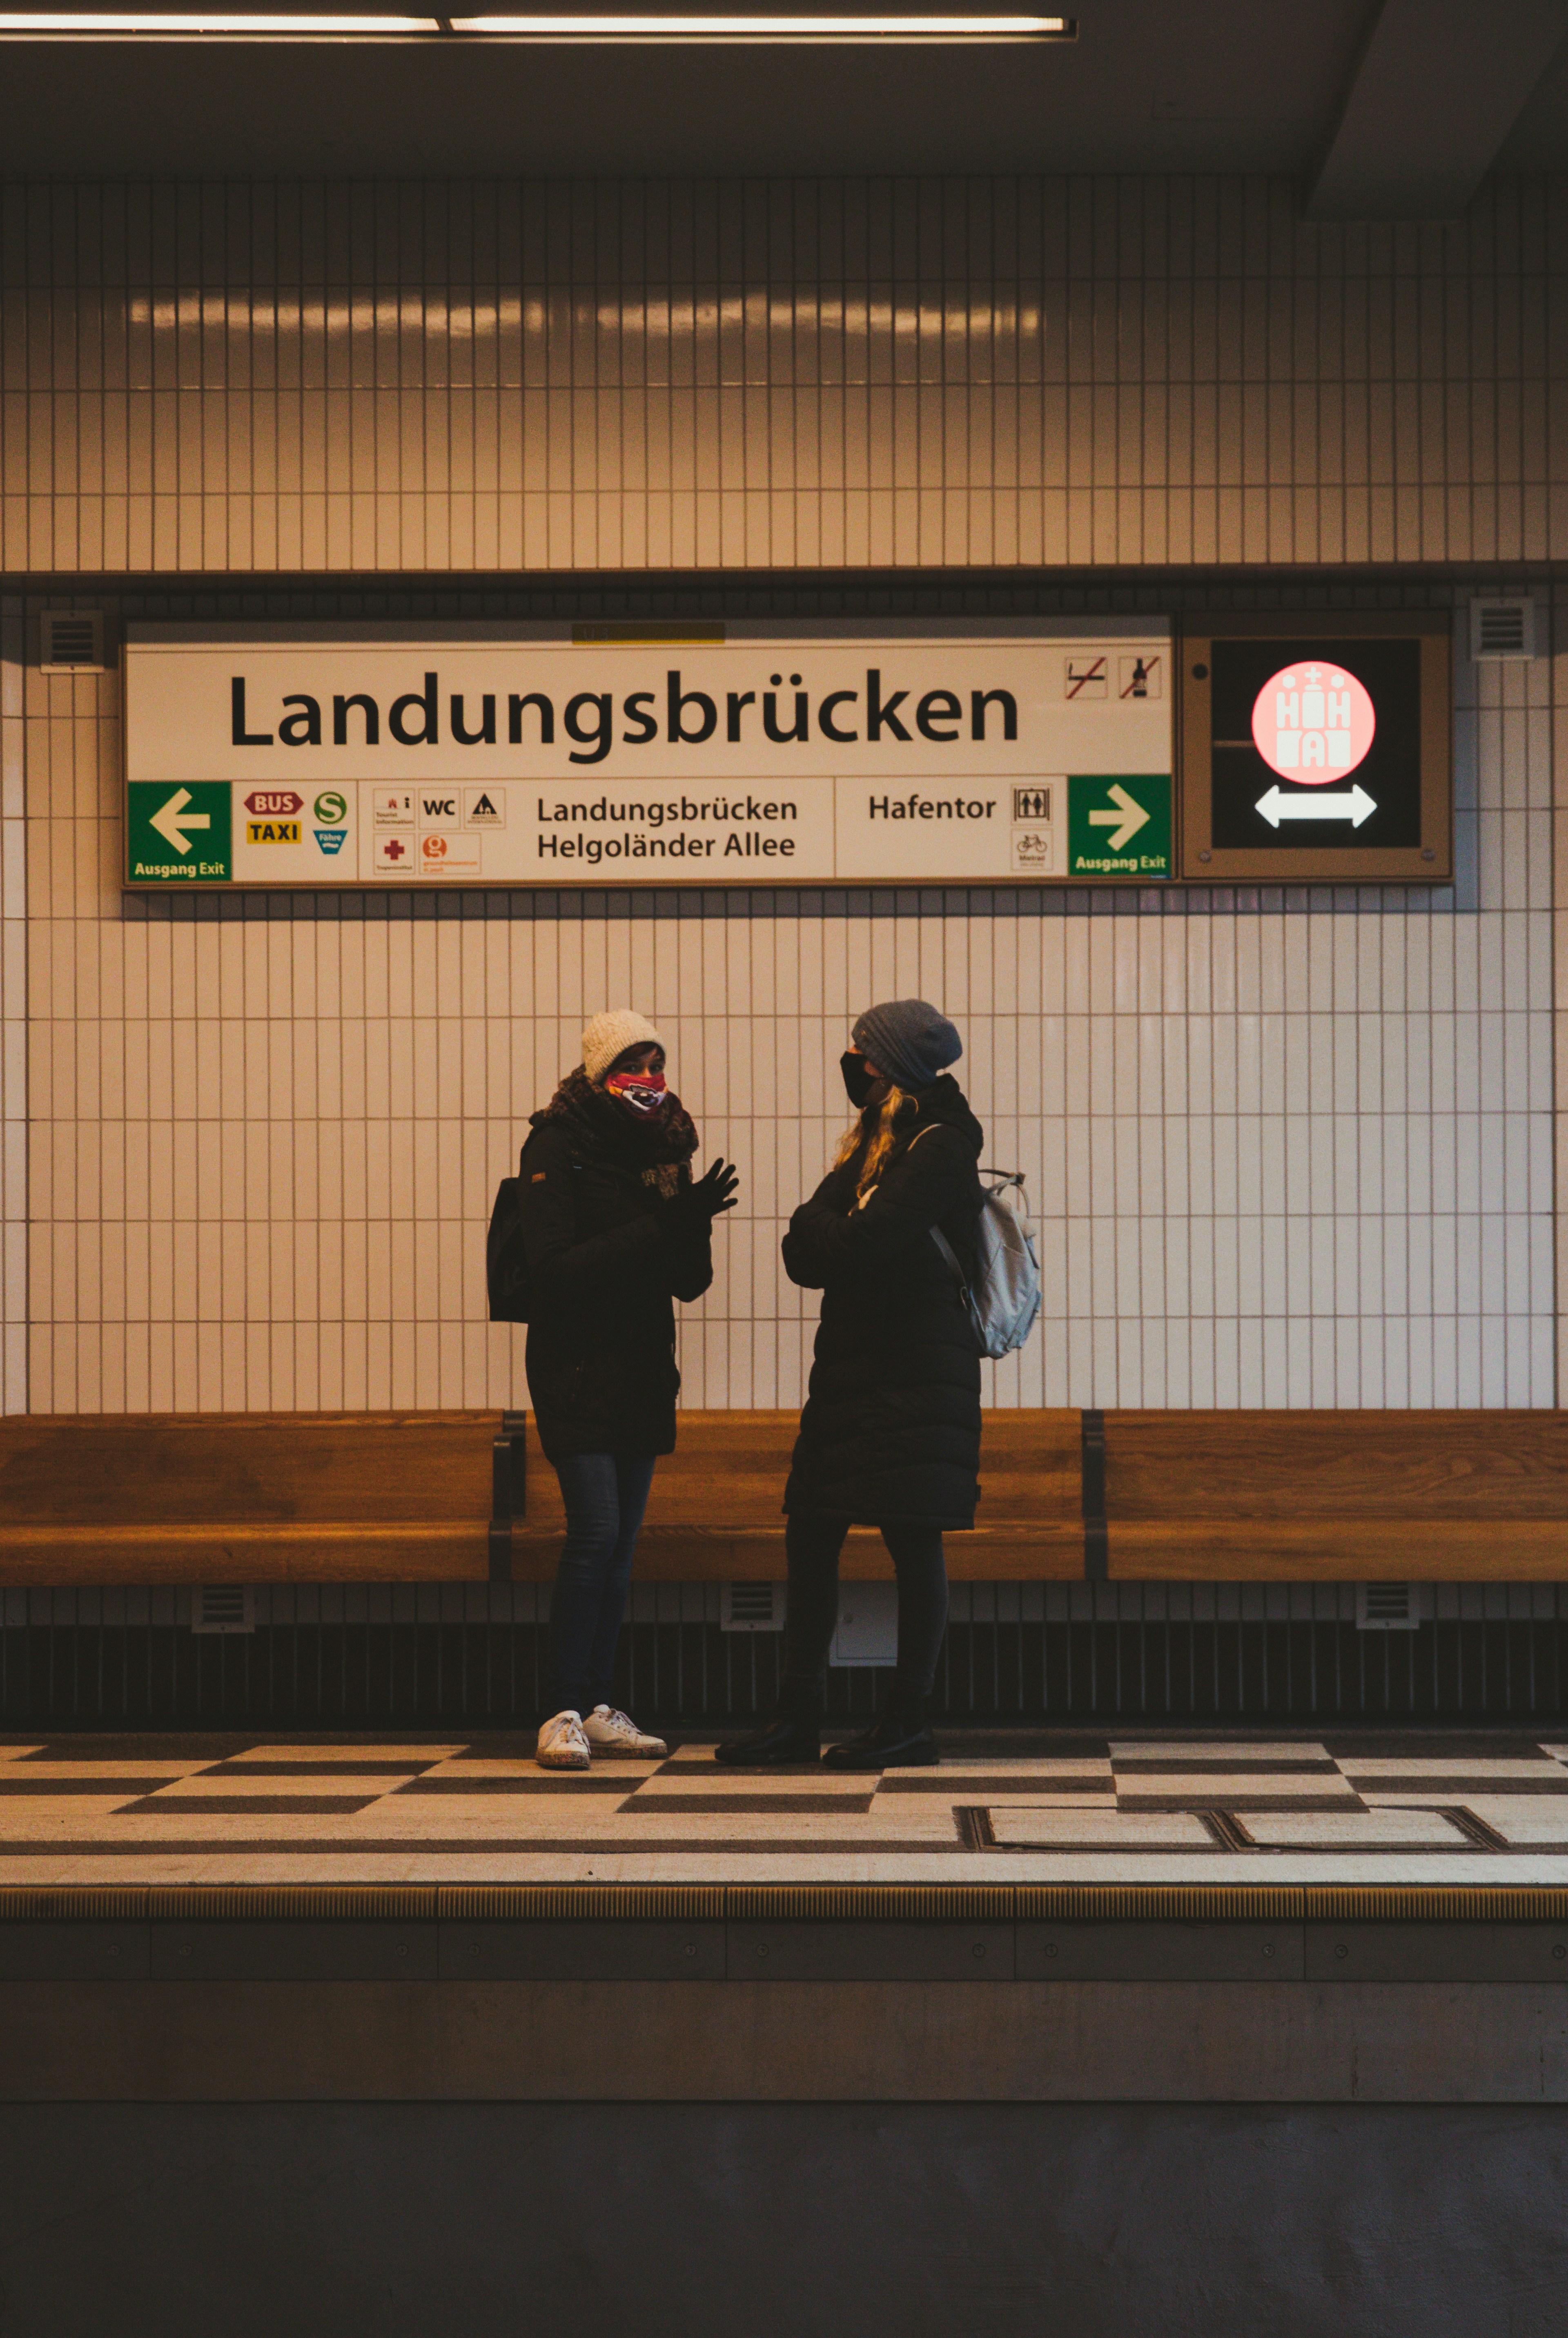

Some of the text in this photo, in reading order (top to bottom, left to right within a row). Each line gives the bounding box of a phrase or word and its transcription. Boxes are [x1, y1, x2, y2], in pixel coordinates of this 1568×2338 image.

[232, 669, 1018, 765] Landungsbrücken
[255, 795, 294, 812] BUS
[423, 800, 455, 816] WC
[538, 796, 797, 827] Landungsbrücken
[870, 794, 997, 820] Hafentor
[250, 824, 298, 841] TAXI
[539, 832, 796, 865] Helgoländer Allee
[135, 862, 225, 878] Ausgang Exit
[1076, 855, 1166, 872] Ausgang Exit
